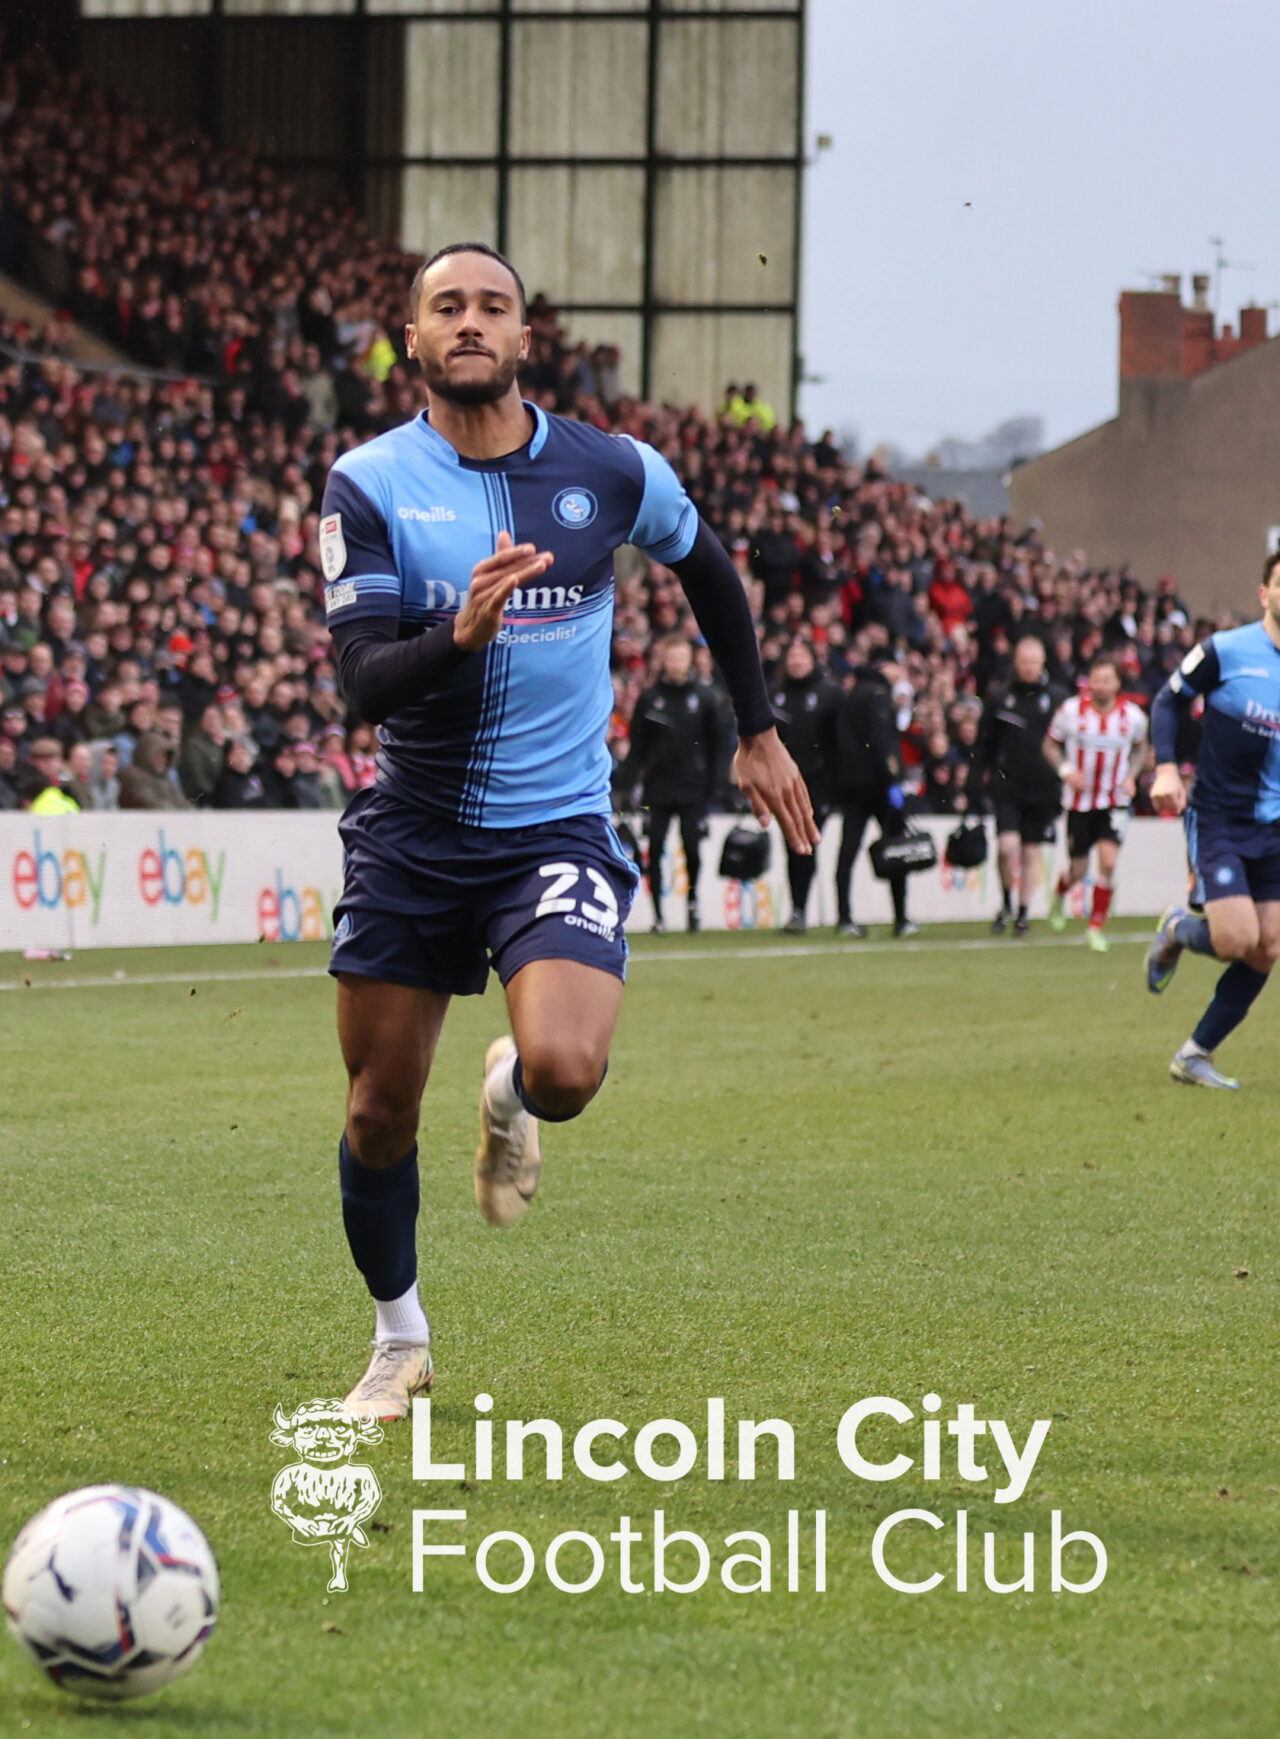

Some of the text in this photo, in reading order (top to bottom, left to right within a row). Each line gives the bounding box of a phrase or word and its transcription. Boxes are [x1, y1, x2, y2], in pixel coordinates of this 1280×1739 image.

[424, 578, 584, 613] Drams
[496, 625, 577, 647] Specialist
[13, 829, 106, 925] ebay
[138, 828, 224, 922] ebay
[536, 862, 619, 928] 23
